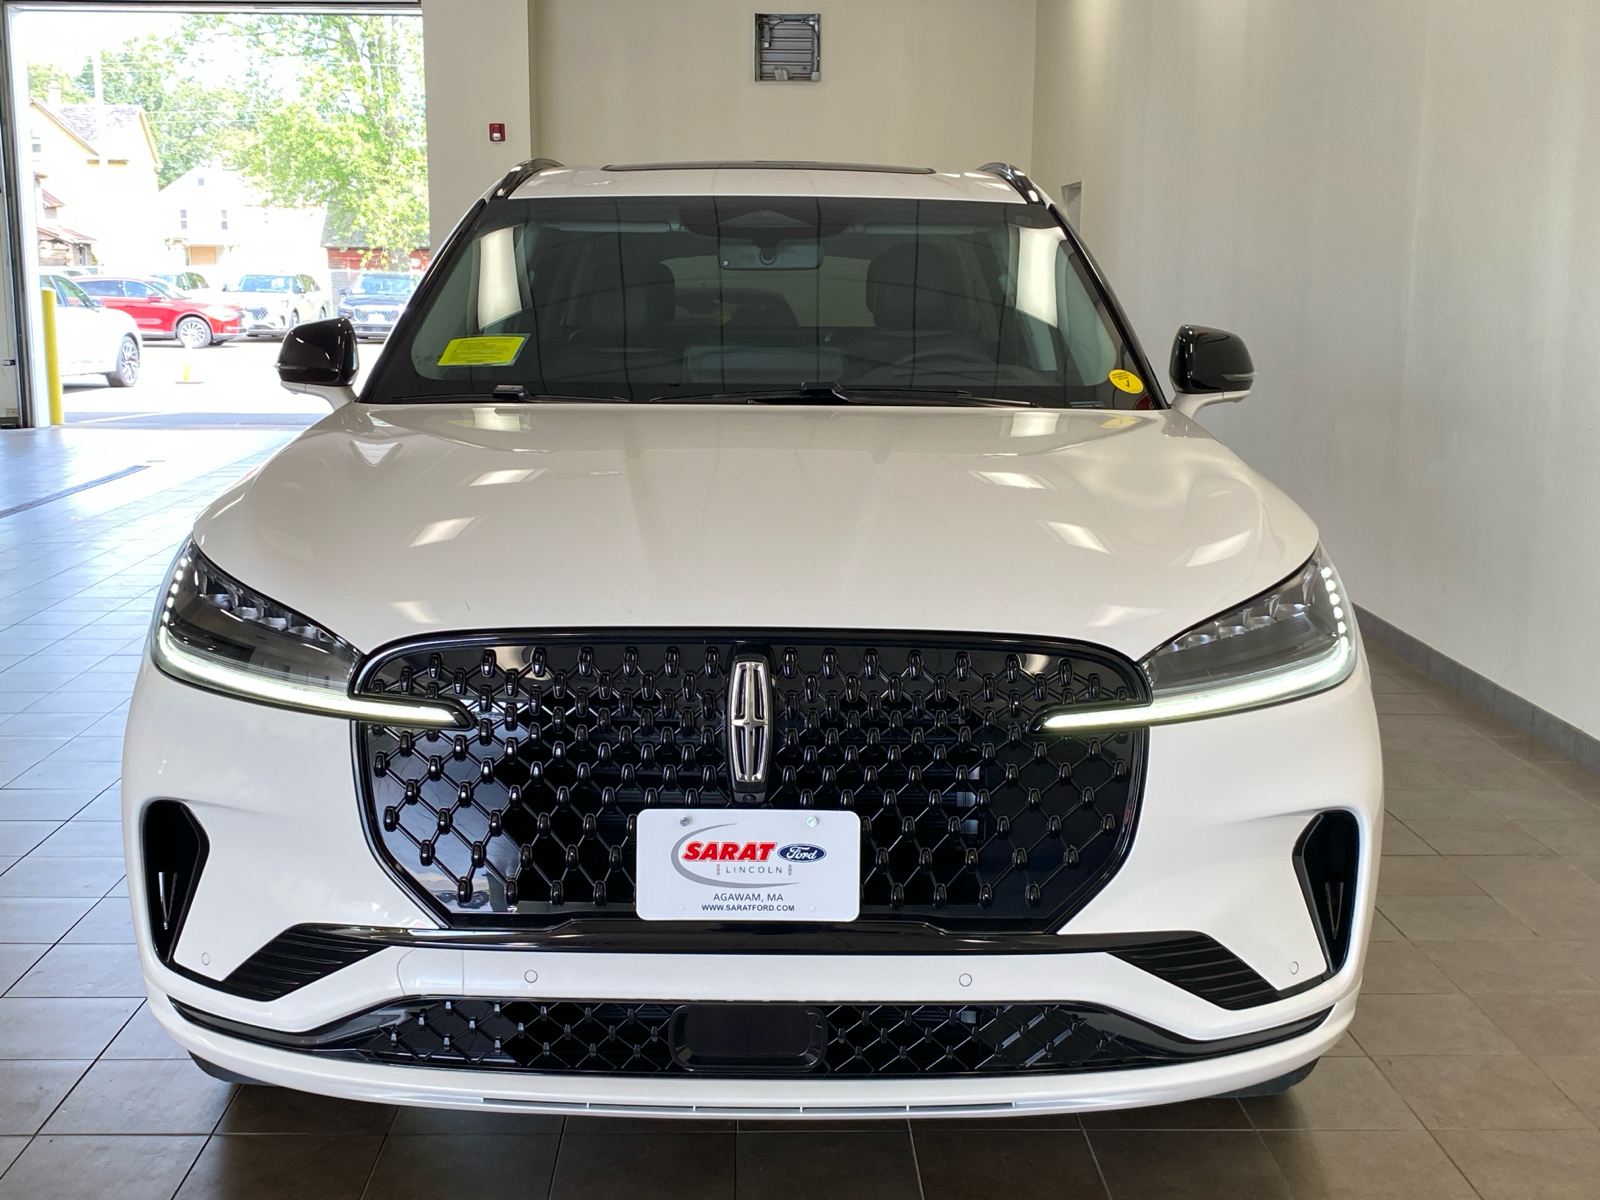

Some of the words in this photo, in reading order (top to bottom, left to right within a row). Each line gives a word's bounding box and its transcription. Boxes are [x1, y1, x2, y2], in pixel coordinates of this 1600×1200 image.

[682, 841, 778, 862] SARAT
[786, 846, 817, 860] Ford
[726, 866, 783, 874] LINCOLN
[713, 892, 764, 903] AGAWAM,
[767, 893, 784, 902] MA
[701, 904, 795, 912] WWW.SARATFORD.COM
